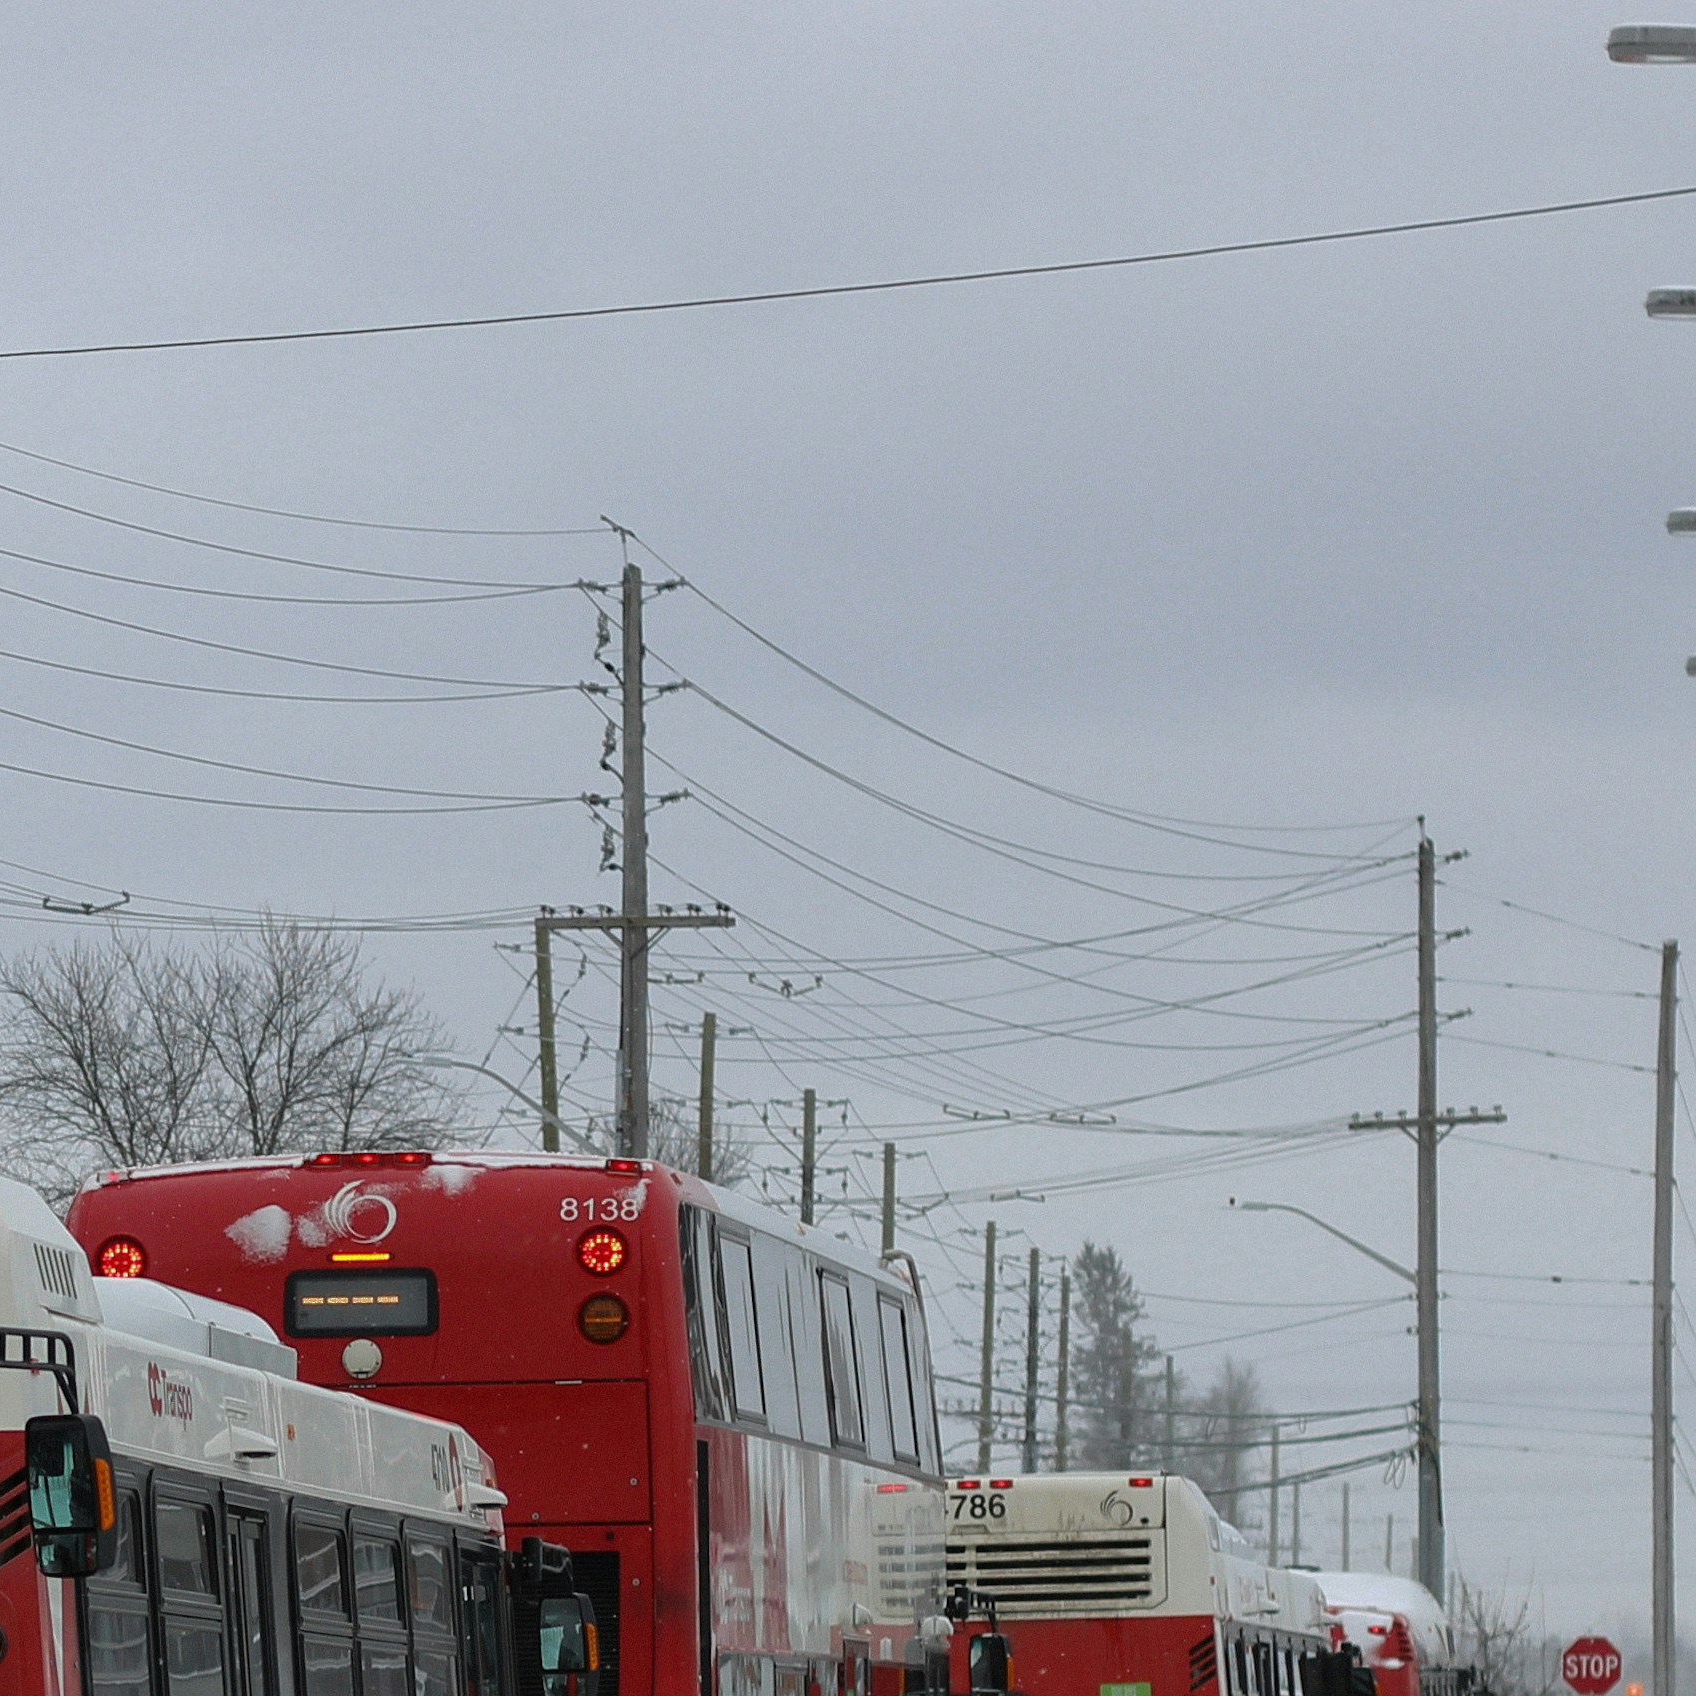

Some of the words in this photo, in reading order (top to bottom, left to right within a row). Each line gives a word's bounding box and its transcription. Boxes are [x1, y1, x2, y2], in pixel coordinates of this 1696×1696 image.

[560, 1197, 639, 1221] 8138
[161, 1369, 193, 1432] Transpo
[945, 1493, 1006, 1519] 786
[1566, 1655, 1619, 1679] STOP
